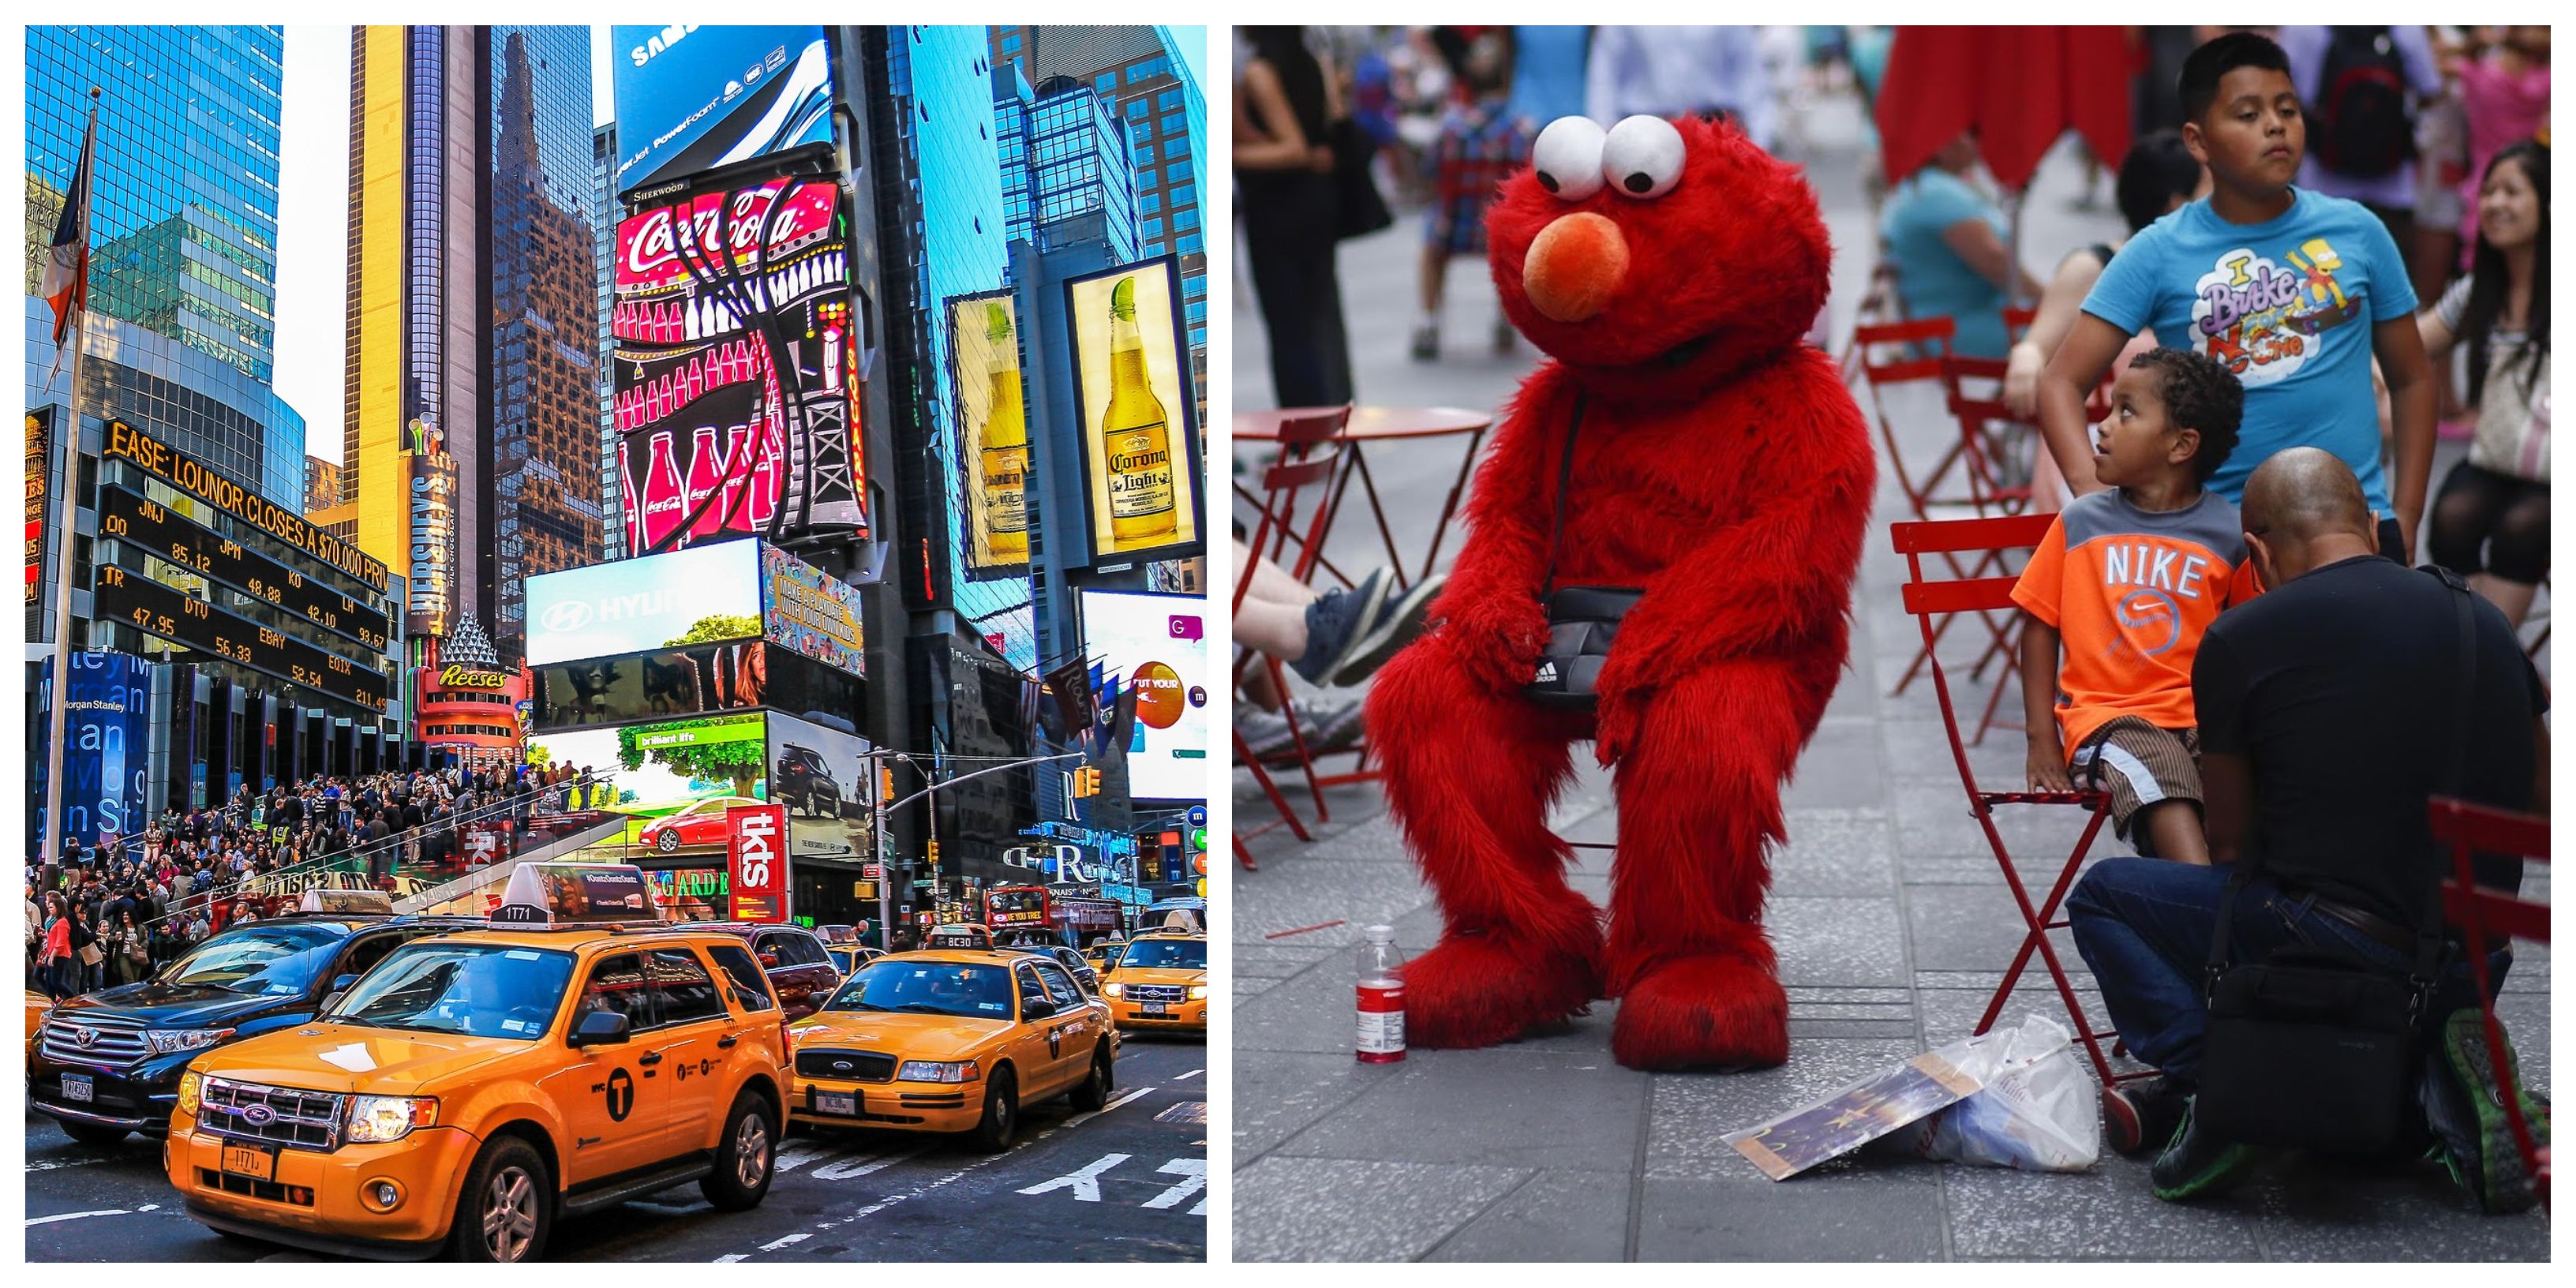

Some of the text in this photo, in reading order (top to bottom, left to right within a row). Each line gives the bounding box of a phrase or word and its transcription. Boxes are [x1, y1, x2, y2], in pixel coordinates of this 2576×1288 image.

[2226, 257, 2250, 286] I
[1110, 450, 1168, 475] Corona
[104, 421, 169, 477] EASE:
[174, 454, 243, 514] LOUNOR
[247, 496, 304, 554] CLOSES
[307, 527, 316, 554] A
[1122, 473, 1157, 492] Light
[138, 499, 164, 524] JNJ
[172, 539, 242, 574] 85.12 JPM
[411, 475, 447, 613] HERSHEY'S
[2106, 544, 2207, 598] NIKE
[185, 597, 208, 620] DTV
[307, 596, 354, 627] 42.10 LH
[780, 577, 843, 623] MAKE A PLAYDATE
[133, 608, 286, 650] 47.95 EBAY
[781, 595, 800, 620] WITH
[803, 605, 822, 630] YOUR
[822, 615, 839, 637] OWN
[359, 627, 384, 649] 93.67
[215, 637, 351, 676] 56.33 EQIX
[292, 665, 321, 687] 52.54
[439, 665, 507, 687] Reese's
[1151, 679, 1178, 689] YOUR
[93, 700, 125, 713] Stanley
[642, 732, 695, 747] brilliant life
[742, 812, 776, 888] tkts
[1052, 845, 1099, 884] R
[661, 871, 729, 897] GARDE
[506, 906, 530, 920] 1T71
[948, 937, 971, 947] 8C30
[592, 1077, 627, 1116] NYC T
